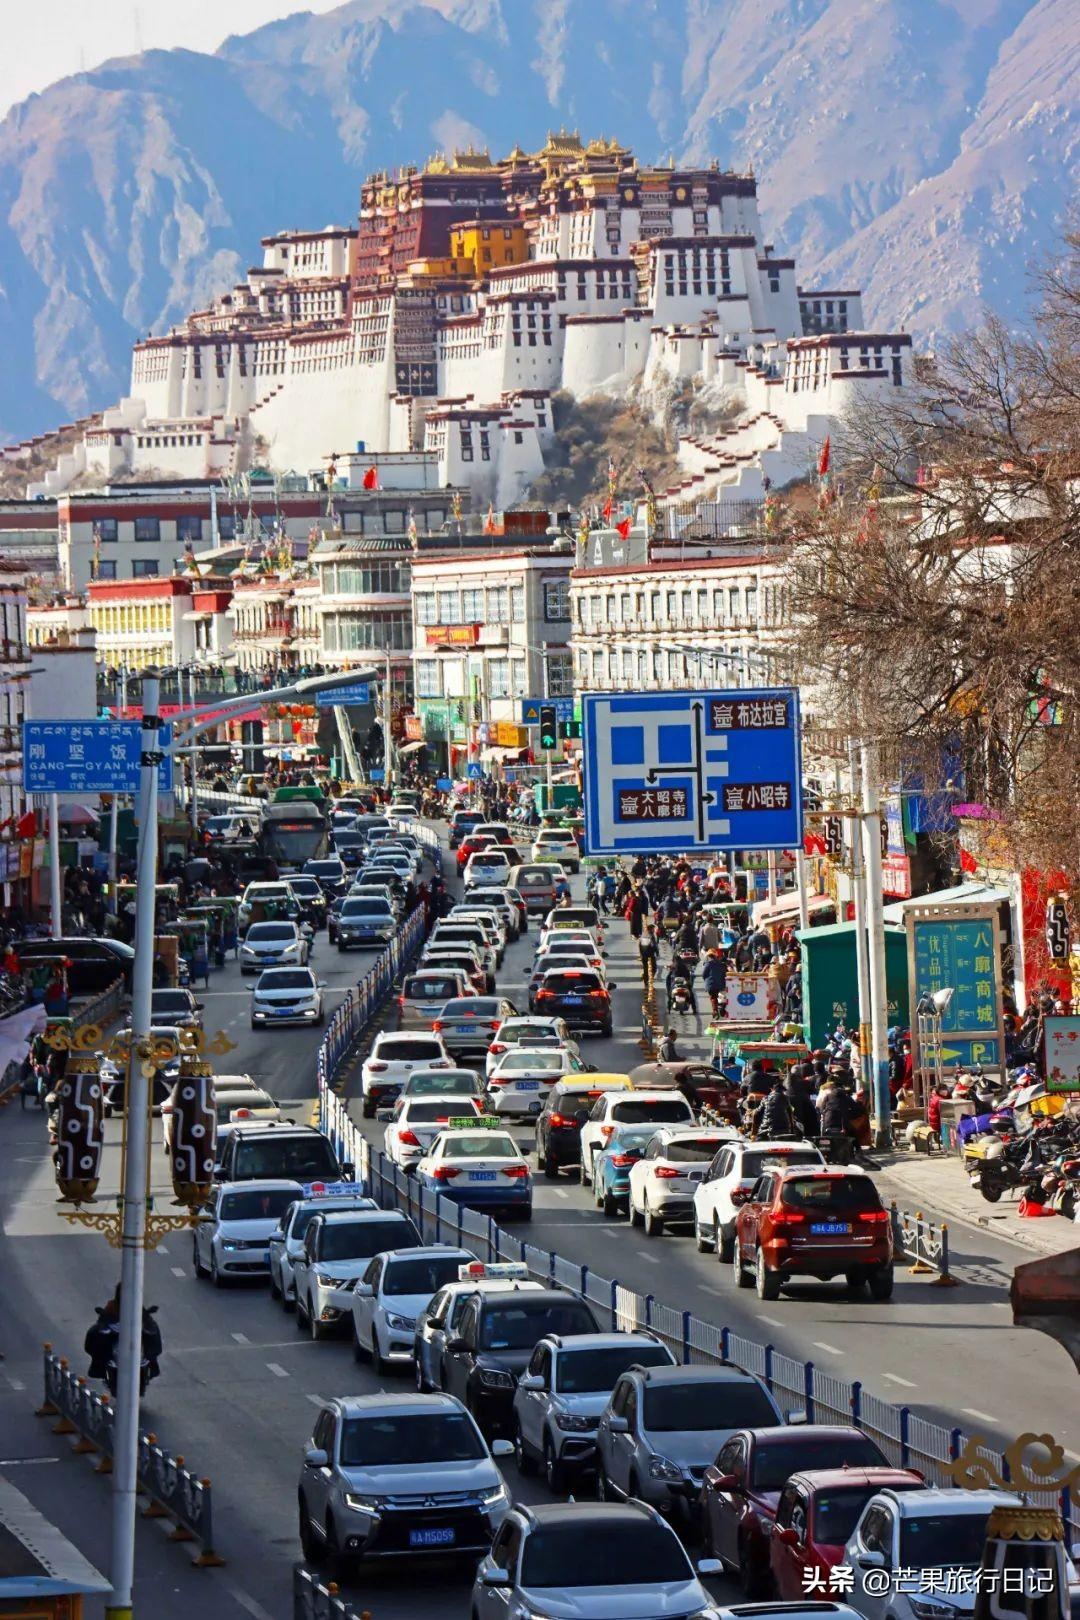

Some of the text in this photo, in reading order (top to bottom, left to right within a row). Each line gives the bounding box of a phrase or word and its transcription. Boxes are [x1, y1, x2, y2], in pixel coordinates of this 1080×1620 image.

[738, 703, 787, 727] 布达拉宫
[127, 762, 166, 770] HOL
[641, 790, 686, 804] 大昭寺
[747, 785, 788, 809] 小昭寺
[641, 804, 687, 818] 八廓街
[975, 931, 993, 1023] 八廓商城
